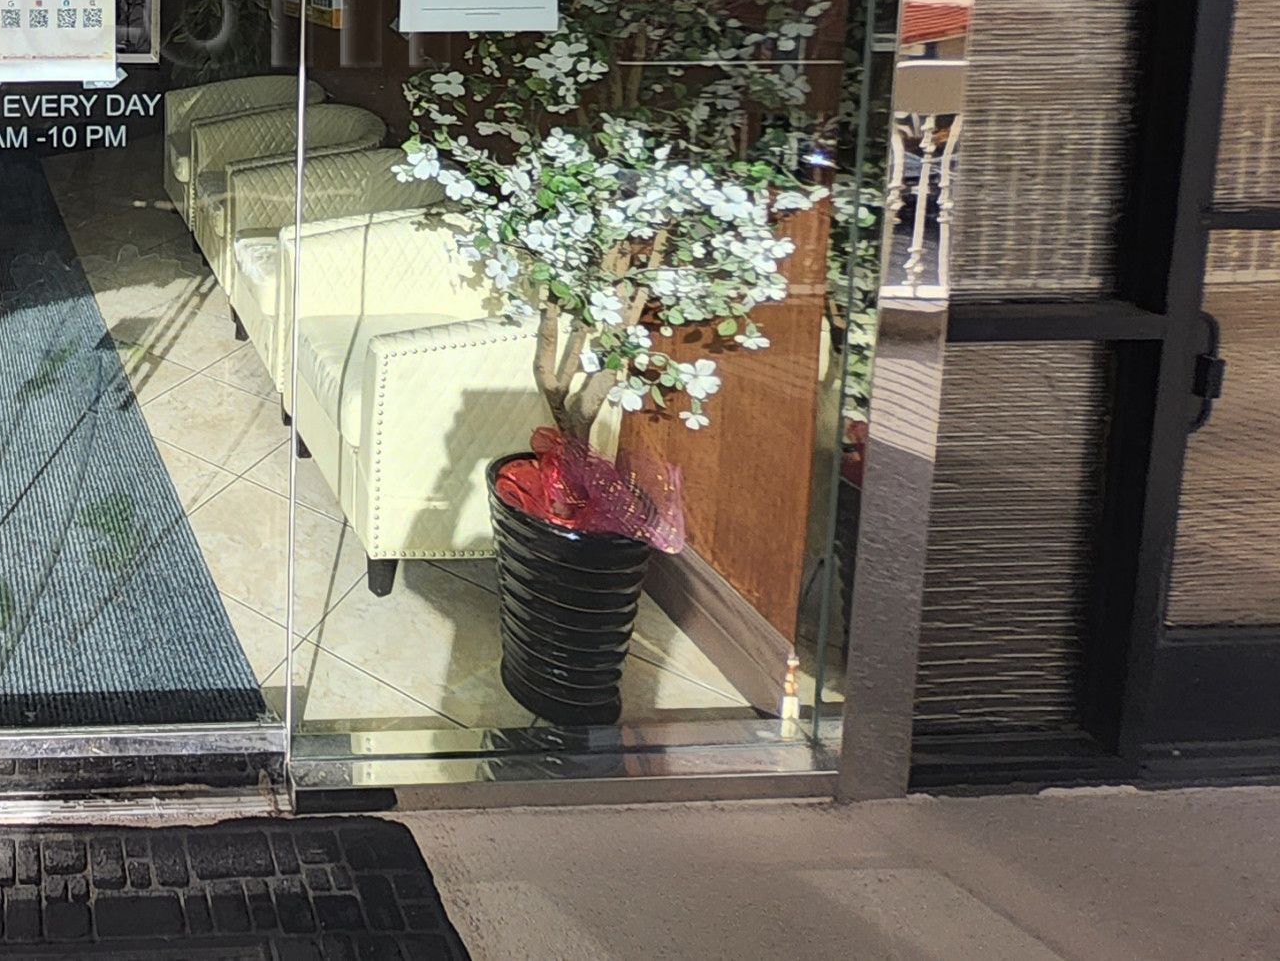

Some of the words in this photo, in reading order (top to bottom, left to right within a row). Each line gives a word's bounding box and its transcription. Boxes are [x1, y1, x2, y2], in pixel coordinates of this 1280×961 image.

[3, 94, 98, 117] EVERY
[106, 94, 161, 116] DAY
[86, 125, 127, 147] PM
